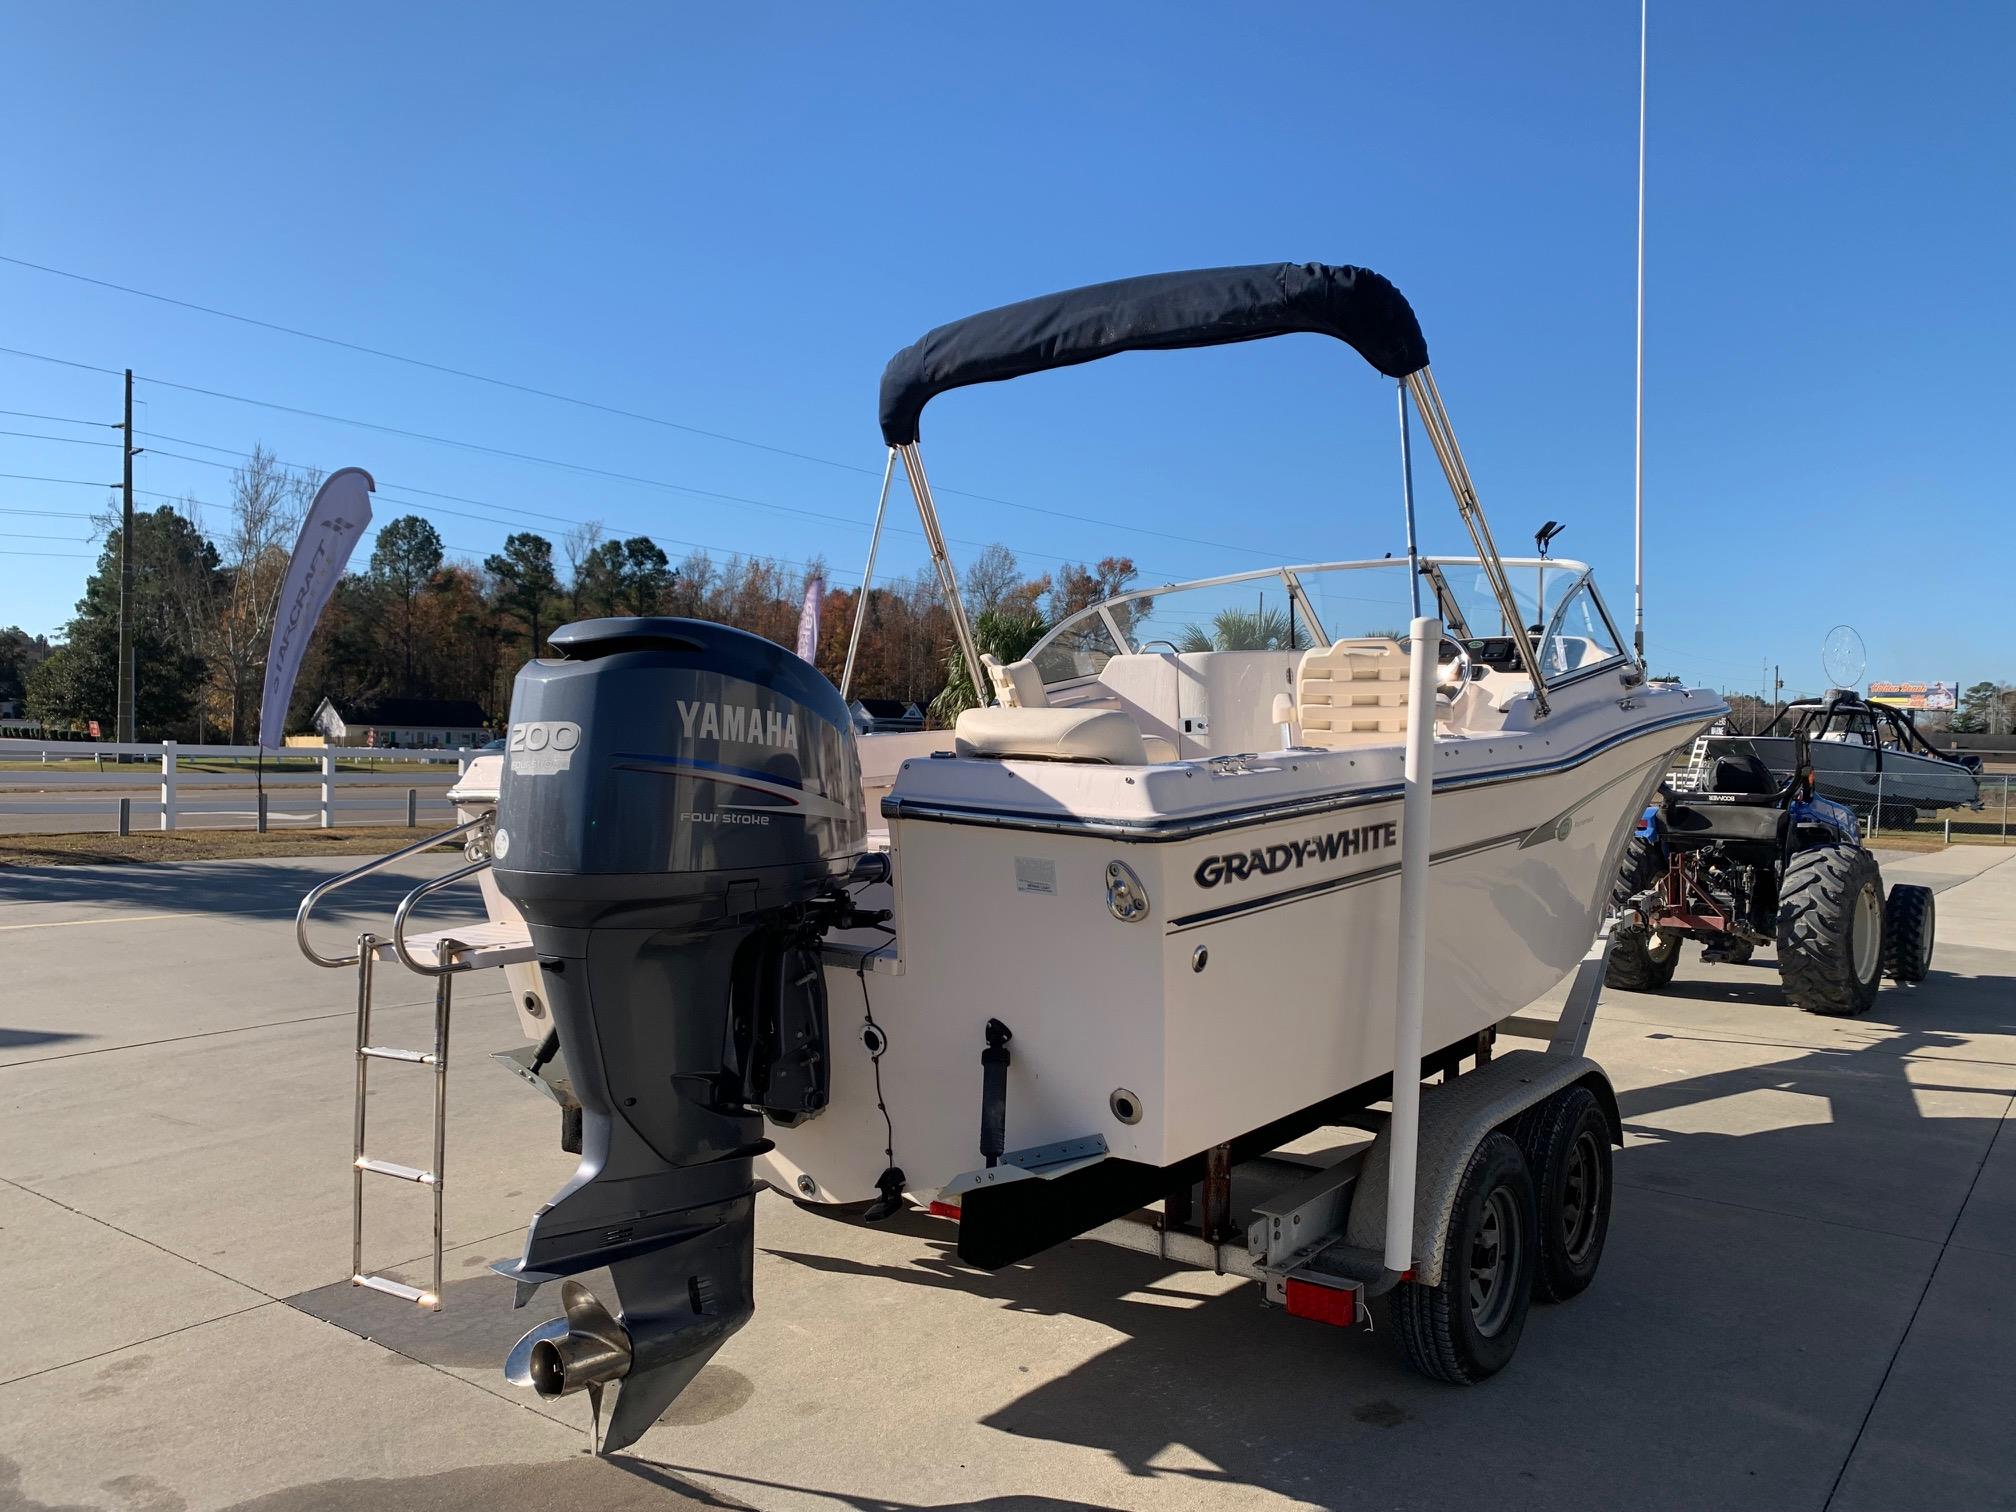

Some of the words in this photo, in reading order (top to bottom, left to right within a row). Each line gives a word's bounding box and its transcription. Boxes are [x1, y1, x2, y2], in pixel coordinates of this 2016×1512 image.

[510, 722, 580, 752] 200
[676, 700, 799, 750] YAMAHA
[1193, 820, 1398, 889] GRADY-WHITE
